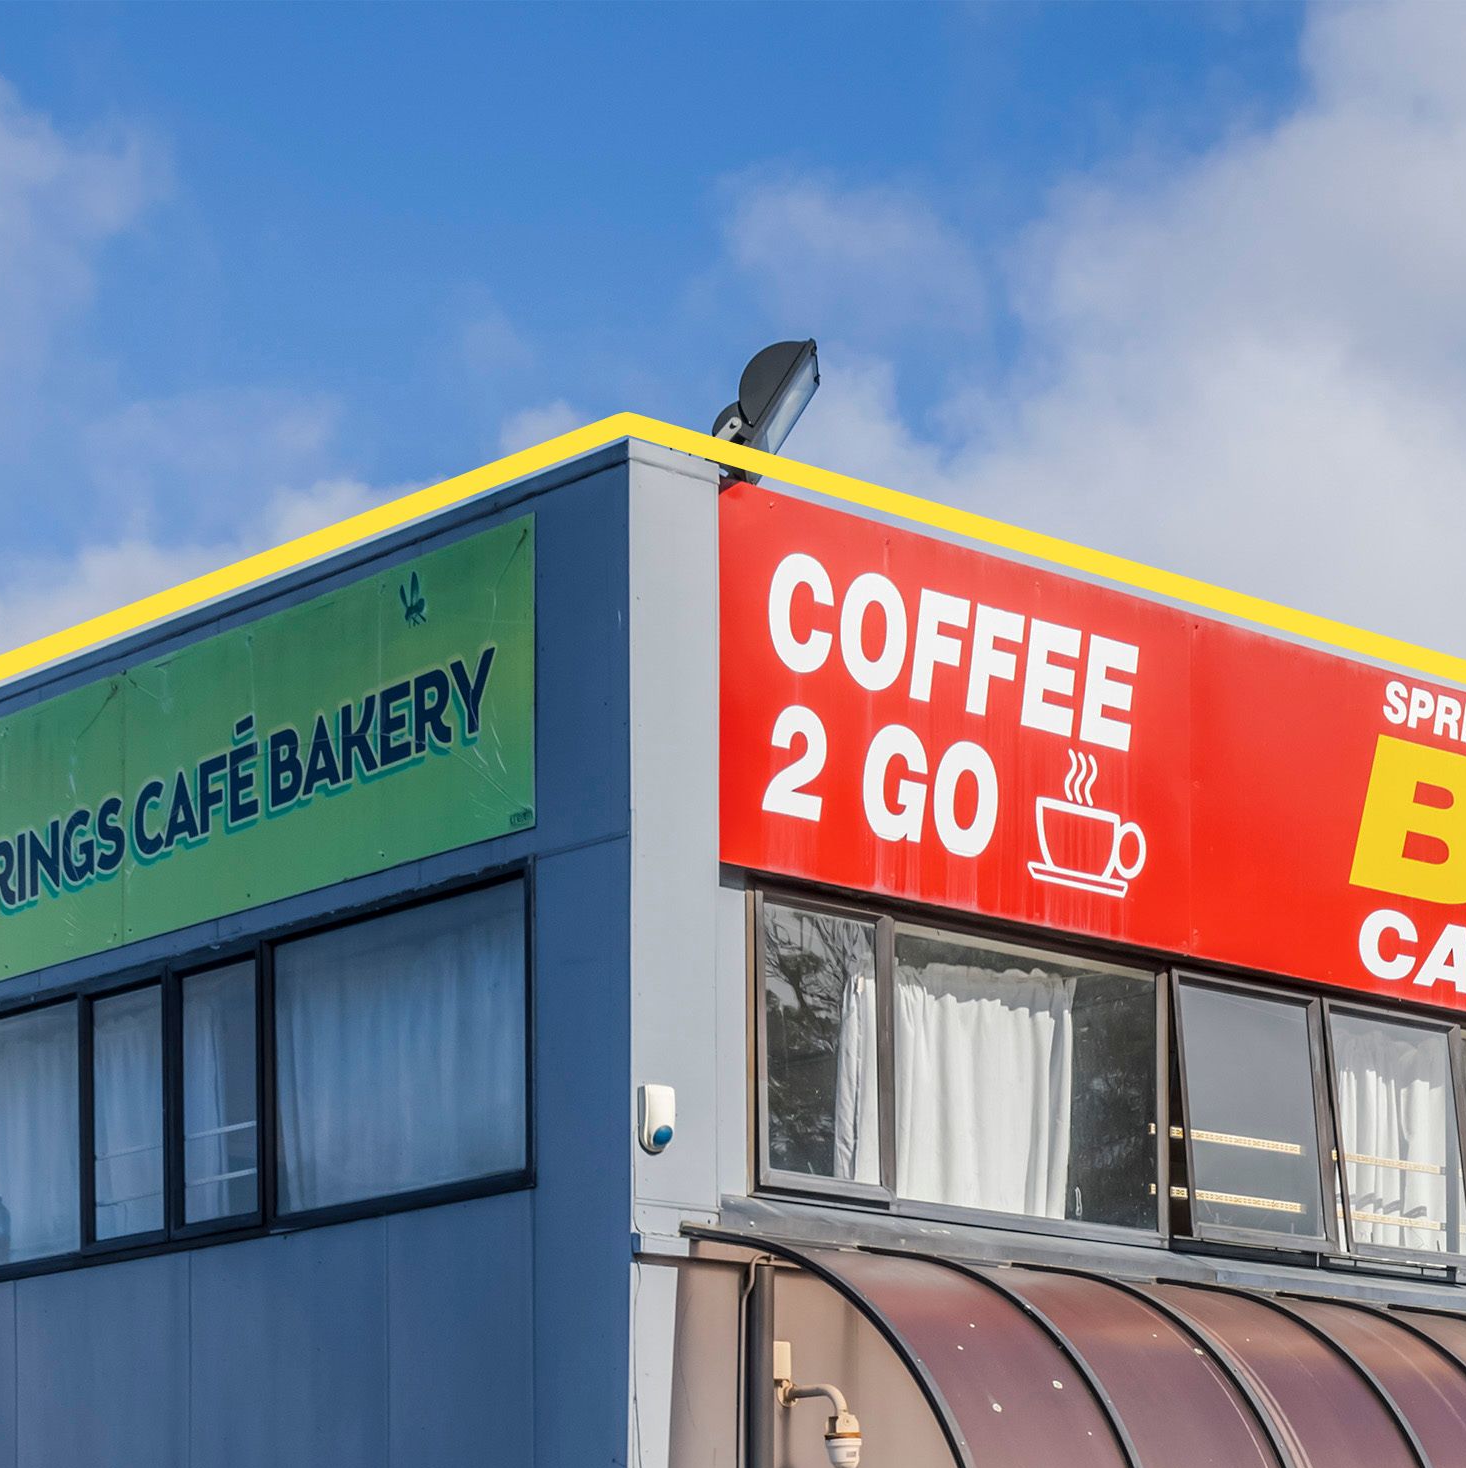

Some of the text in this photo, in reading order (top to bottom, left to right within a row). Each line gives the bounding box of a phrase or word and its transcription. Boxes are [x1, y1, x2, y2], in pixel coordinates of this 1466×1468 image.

[768, 552, 1140, 752] COFFEE
[132, 714, 260, 860] CAFÉ
[268, 645, 497, 812] BAKERY
[762, 704, 999, 858] 2 GO
